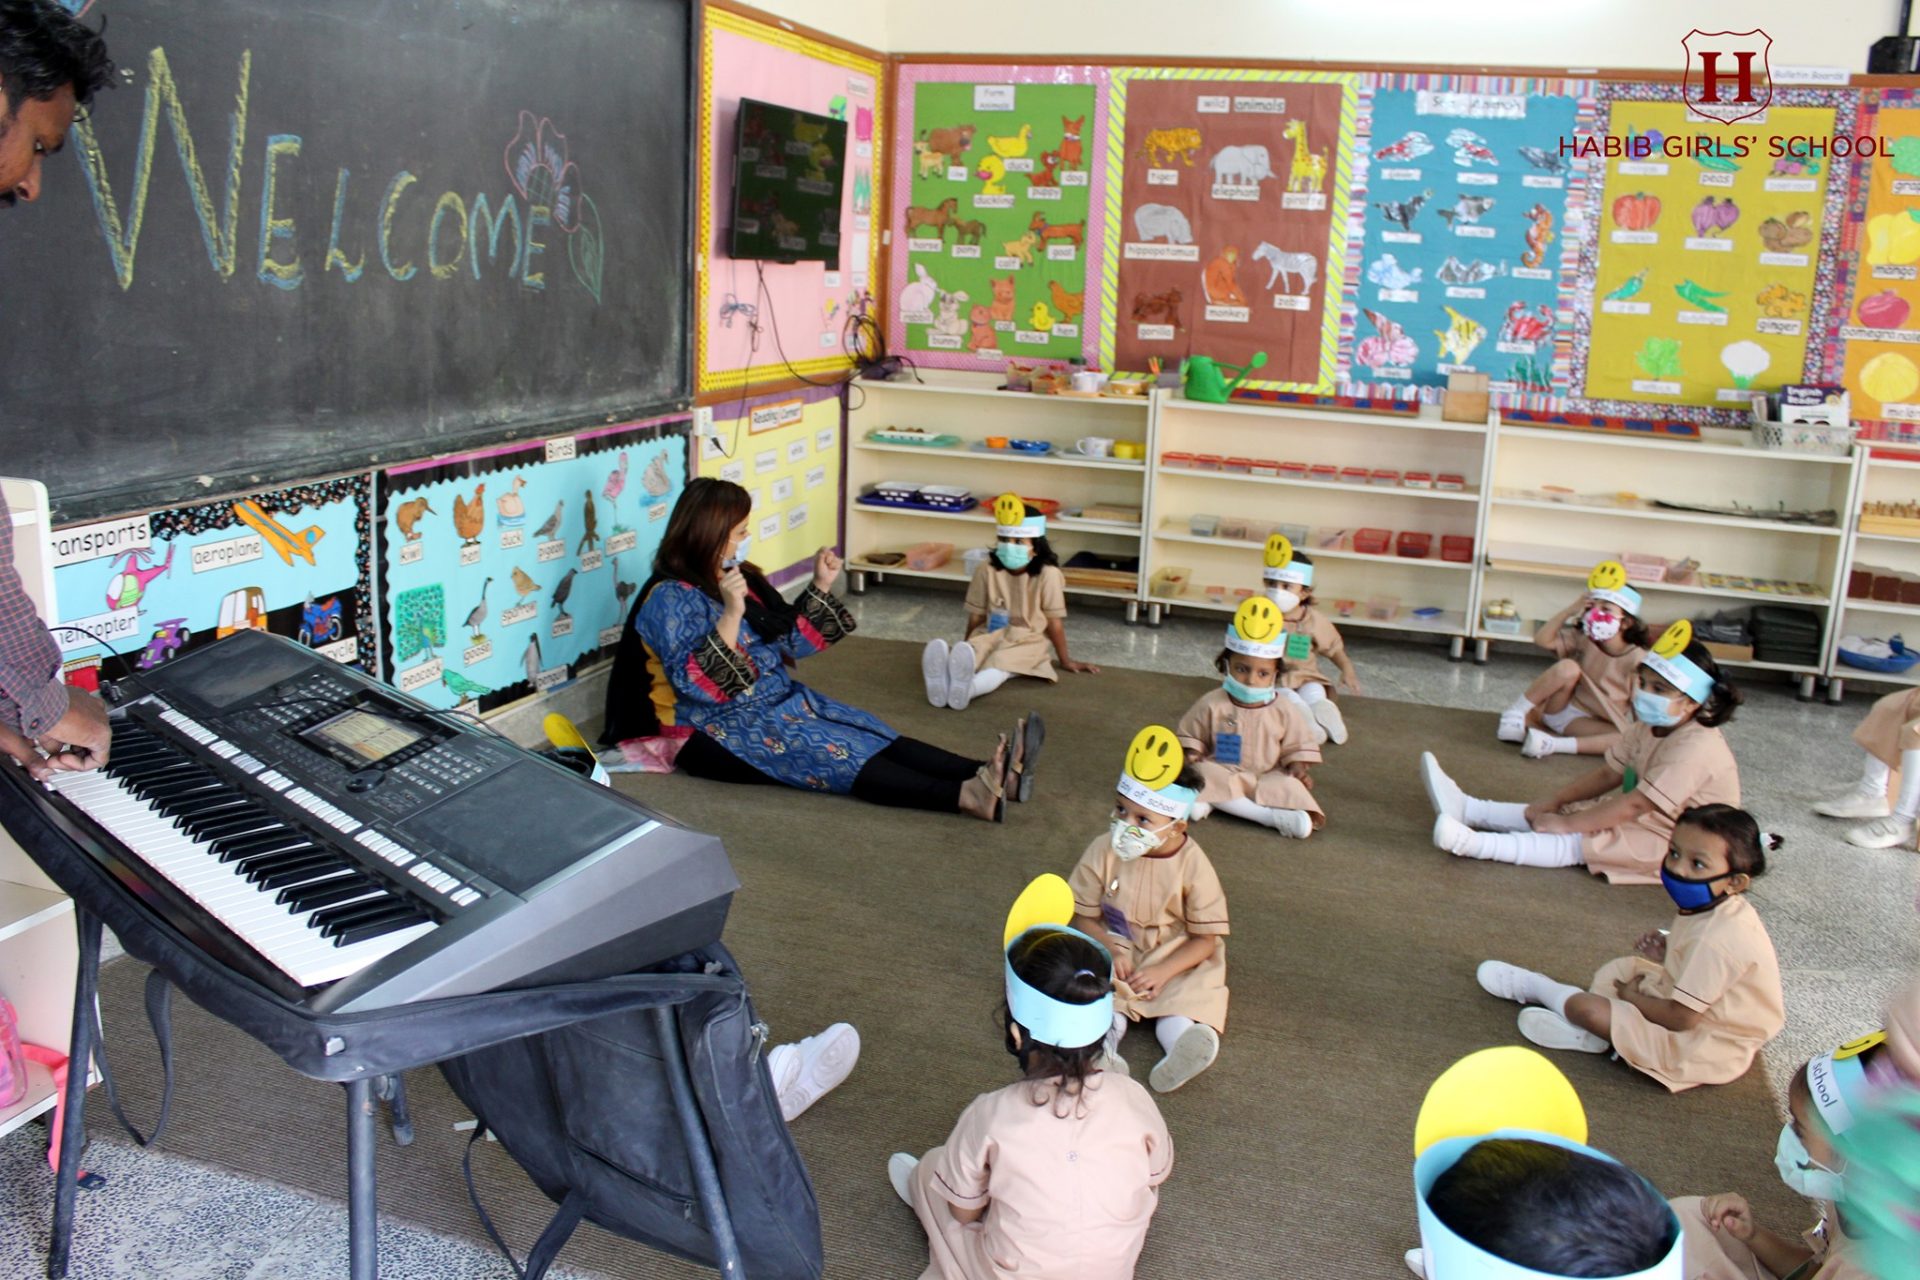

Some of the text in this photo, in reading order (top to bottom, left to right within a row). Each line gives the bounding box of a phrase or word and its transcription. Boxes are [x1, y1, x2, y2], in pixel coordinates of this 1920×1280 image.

[1812, 70, 1844, 81] Boards
[1235, 100, 1286, 112] animals
[71, 46, 549, 292] WELCOME
[1007, 160, 1031, 170] duck
[1067, 174, 1084, 186] dog
[1702, 173, 1730, 185] peas
[1212, 184, 1260, 199] elephant
[975, 195, 1015, 207] duckling
[956, 246, 979, 257] pony
[1127, 244, 1197, 260] hippopotamus
[997, 257, 1018, 268] calf
[1875, 266, 1915, 279] mango
[1208, 307, 1247, 321] monkey
[1140, 326, 1172, 340] gorilla
[1758, 320, 1799, 335] ginger
[1018, 333, 1045, 343] chick
[1786, 386, 1824, 398] English
[1787, 395, 1821, 405] Reader
[547, 441, 573, 459] Birds
[51, 522, 148, 556] ansports
[501, 534, 522, 547] duck
[193, 540, 261, 566] aeroplane
[463, 641, 491, 667] goose
[401, 661, 442, 689] peacock
[1133, 789, 1148, 800] of
[1146, 797, 1177, 813] school
[1812, 1062, 1839, 1109] school
